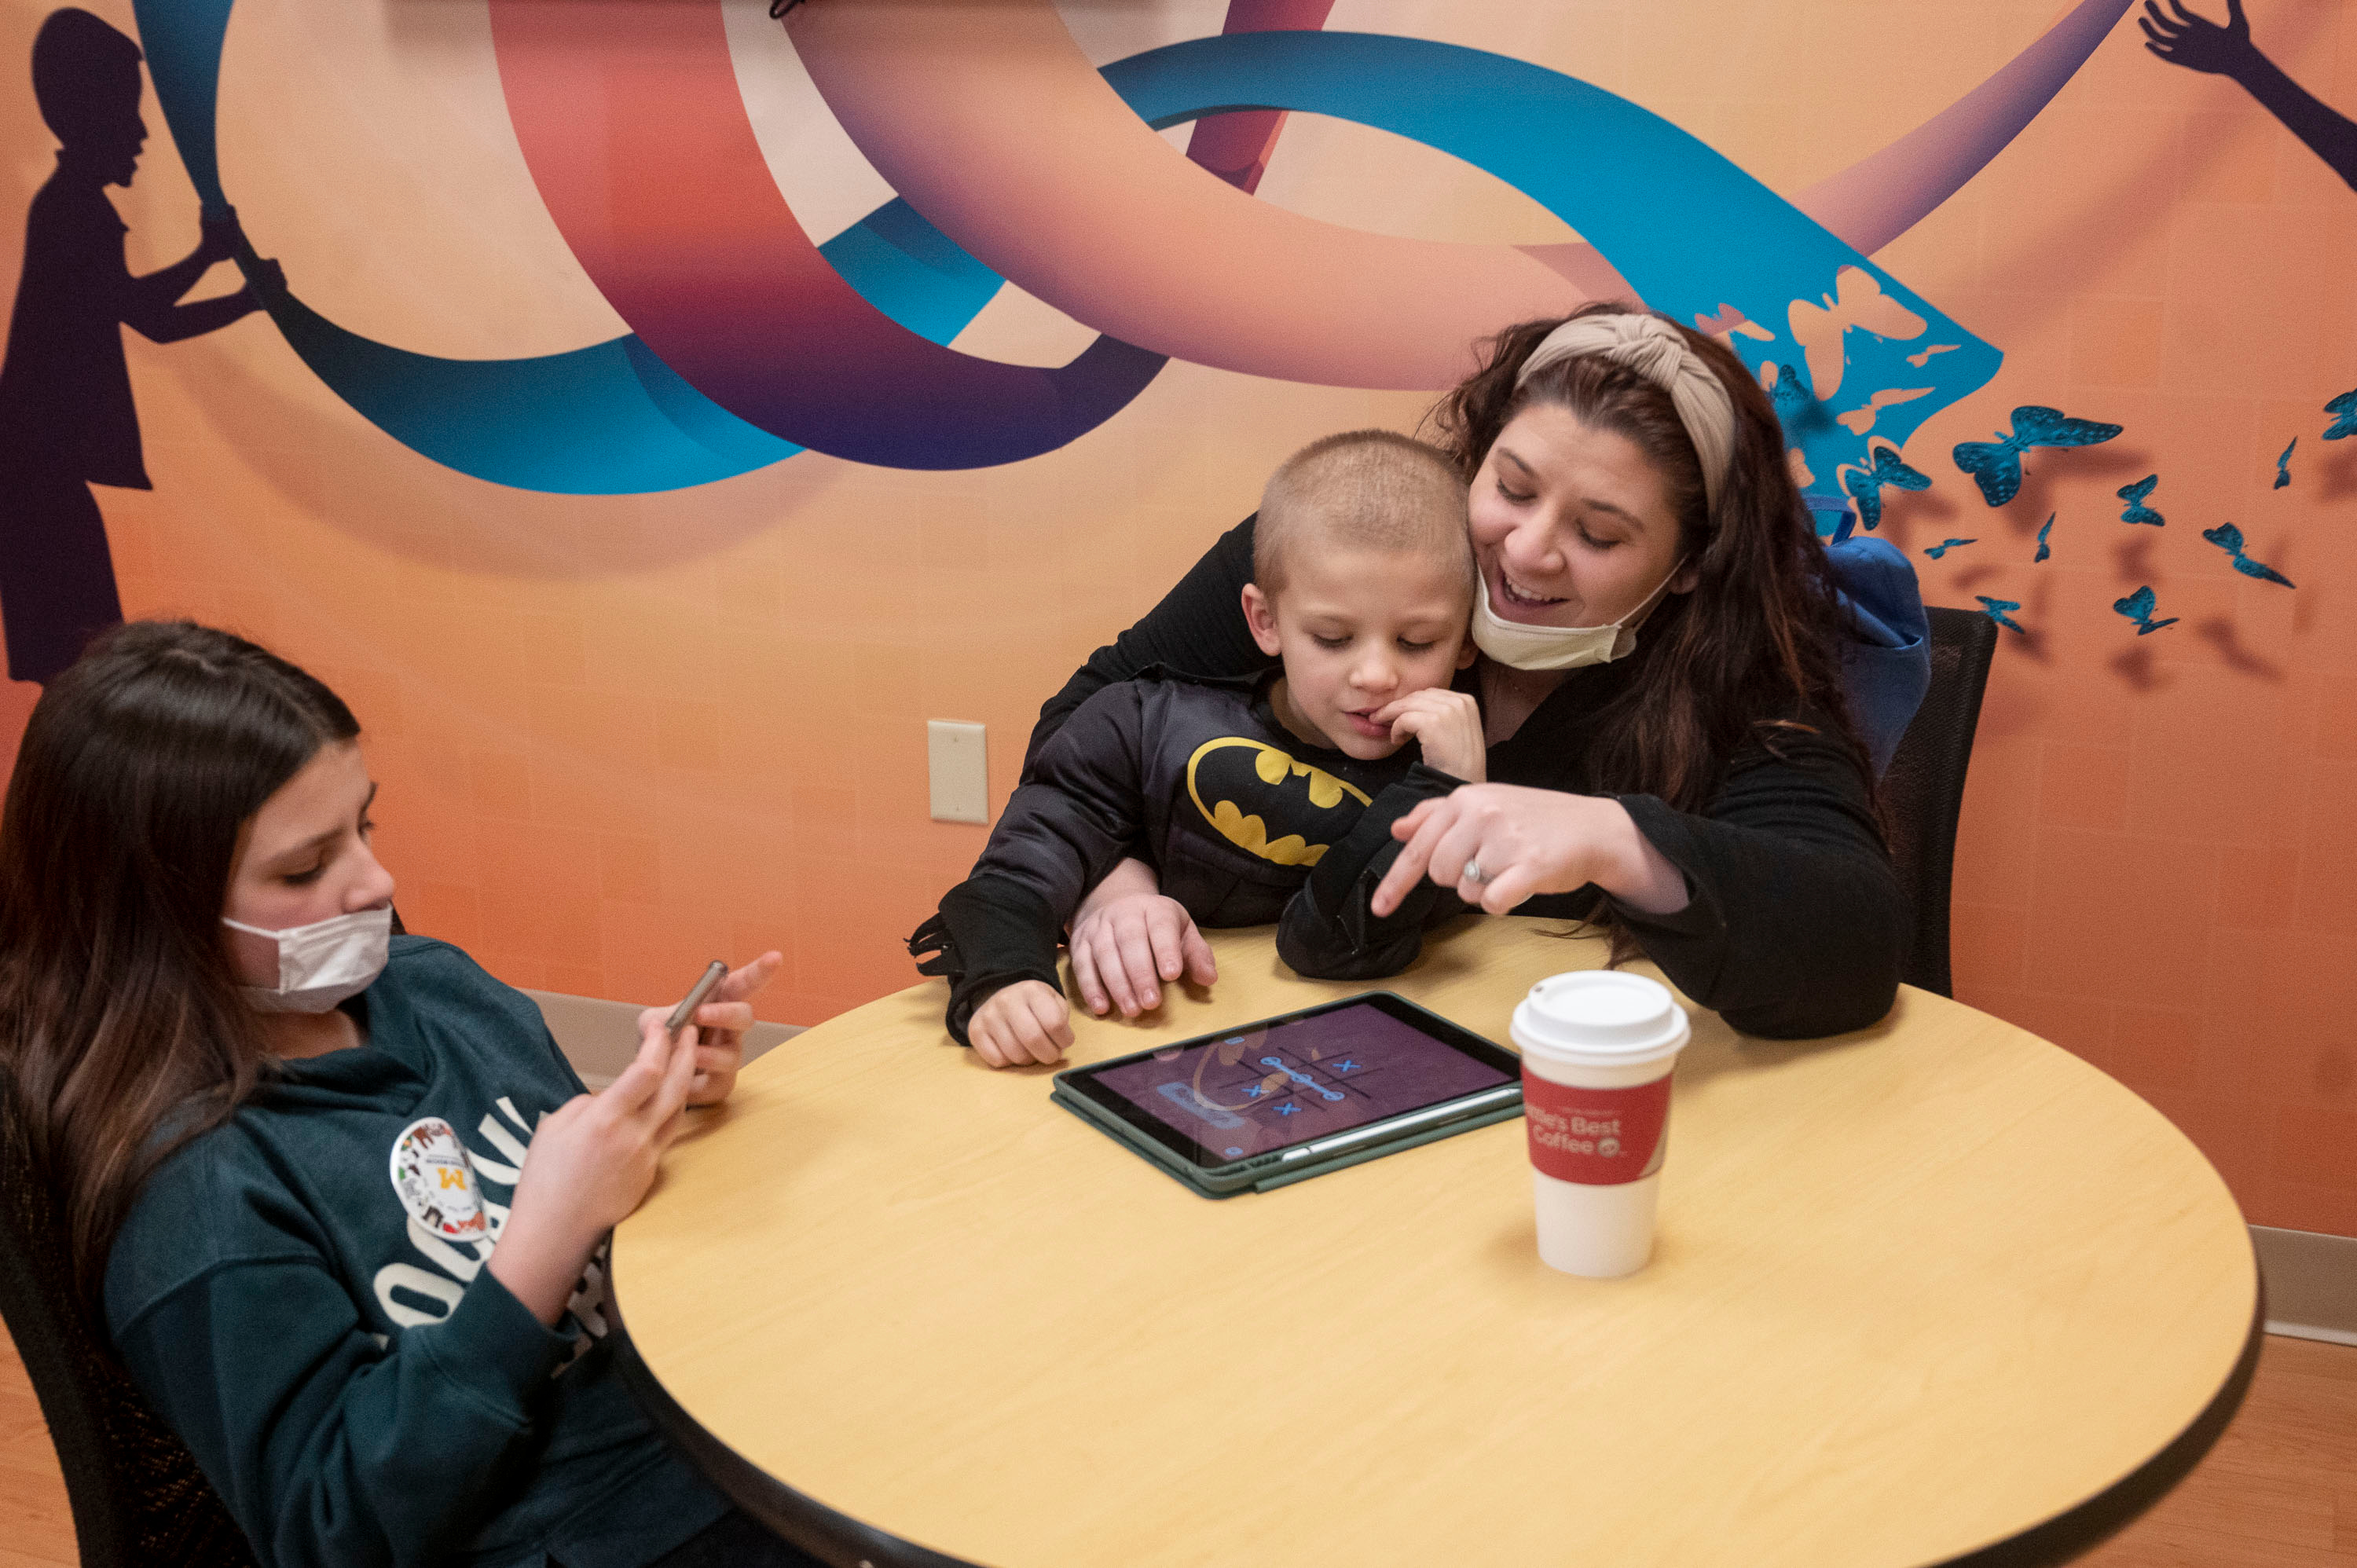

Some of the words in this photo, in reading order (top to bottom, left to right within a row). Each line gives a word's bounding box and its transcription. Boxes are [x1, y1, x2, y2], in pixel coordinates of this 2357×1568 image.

[1571, 1116, 1620, 1136] Best
[1533, 1124, 1594, 1154] Coffee
[438, 1167, 467, 1190] M
